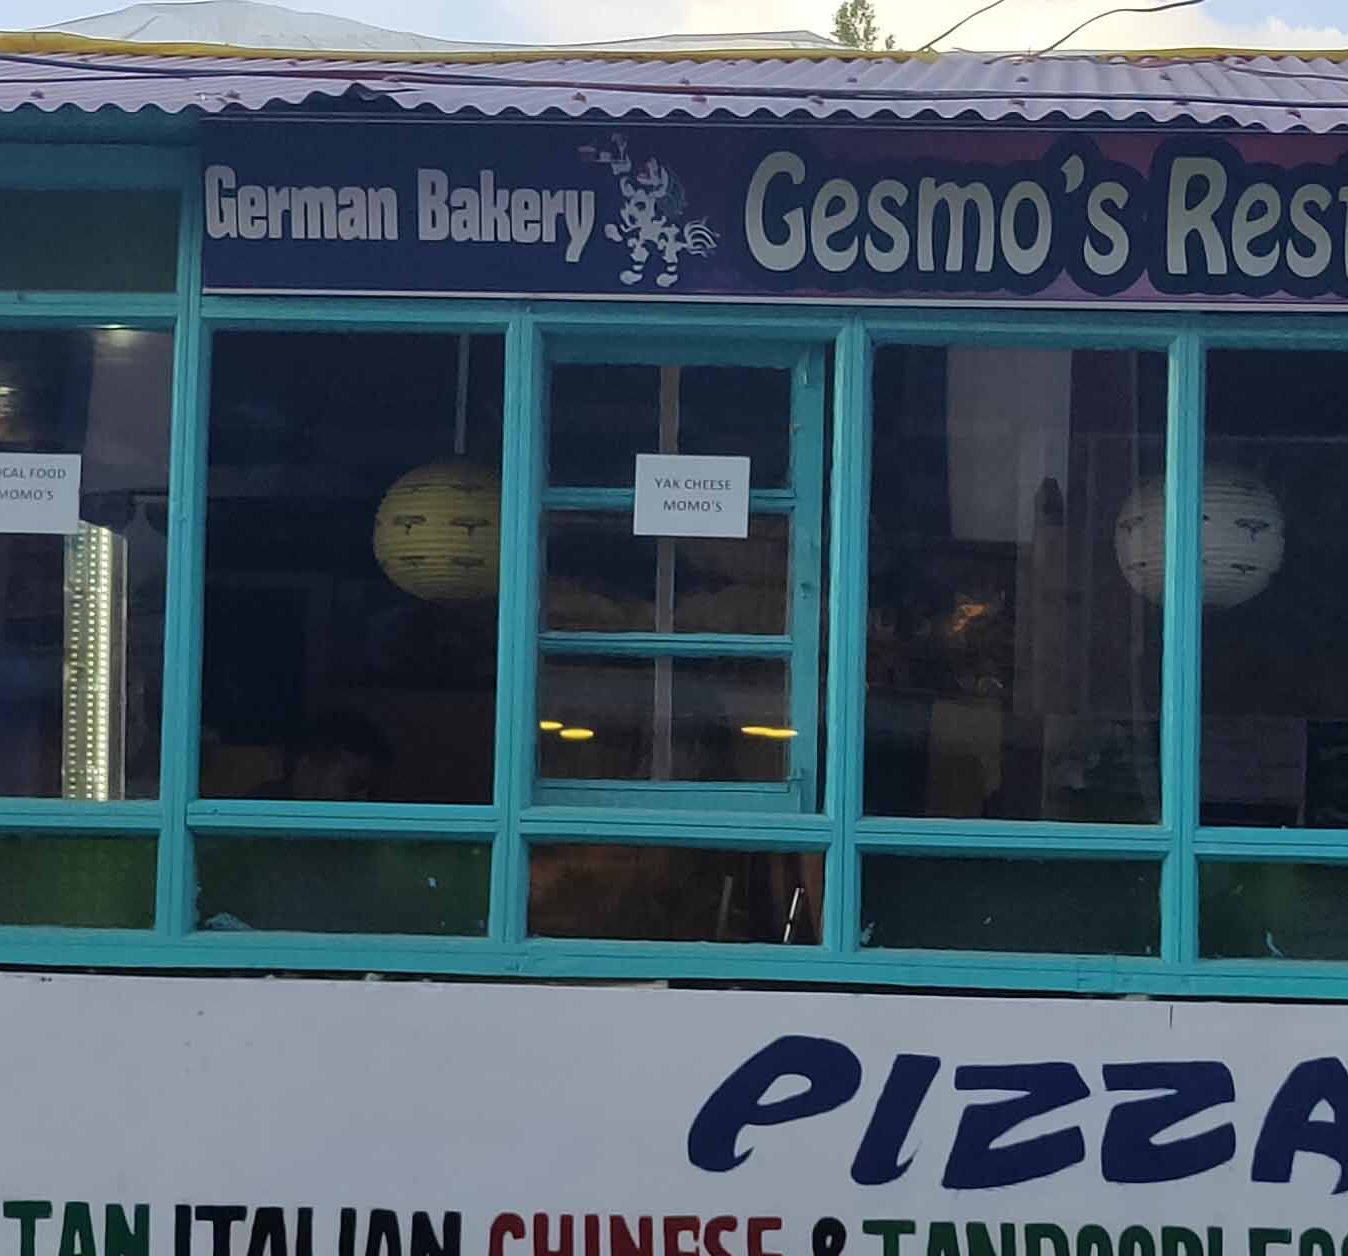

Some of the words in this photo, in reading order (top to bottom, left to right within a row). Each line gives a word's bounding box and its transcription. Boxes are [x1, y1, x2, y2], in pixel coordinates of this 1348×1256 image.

[205, 165, 399, 241] German
[417, 168, 595, 263] Bakery
[744, 151, 1130, 276] Gesmo's
[29, 468, 66, 479] FOOD
[654, 478, 681, 489] YAK
[684, 479, 733, 490] CHEESE
[663, 500, 723, 513] MOMO'S
